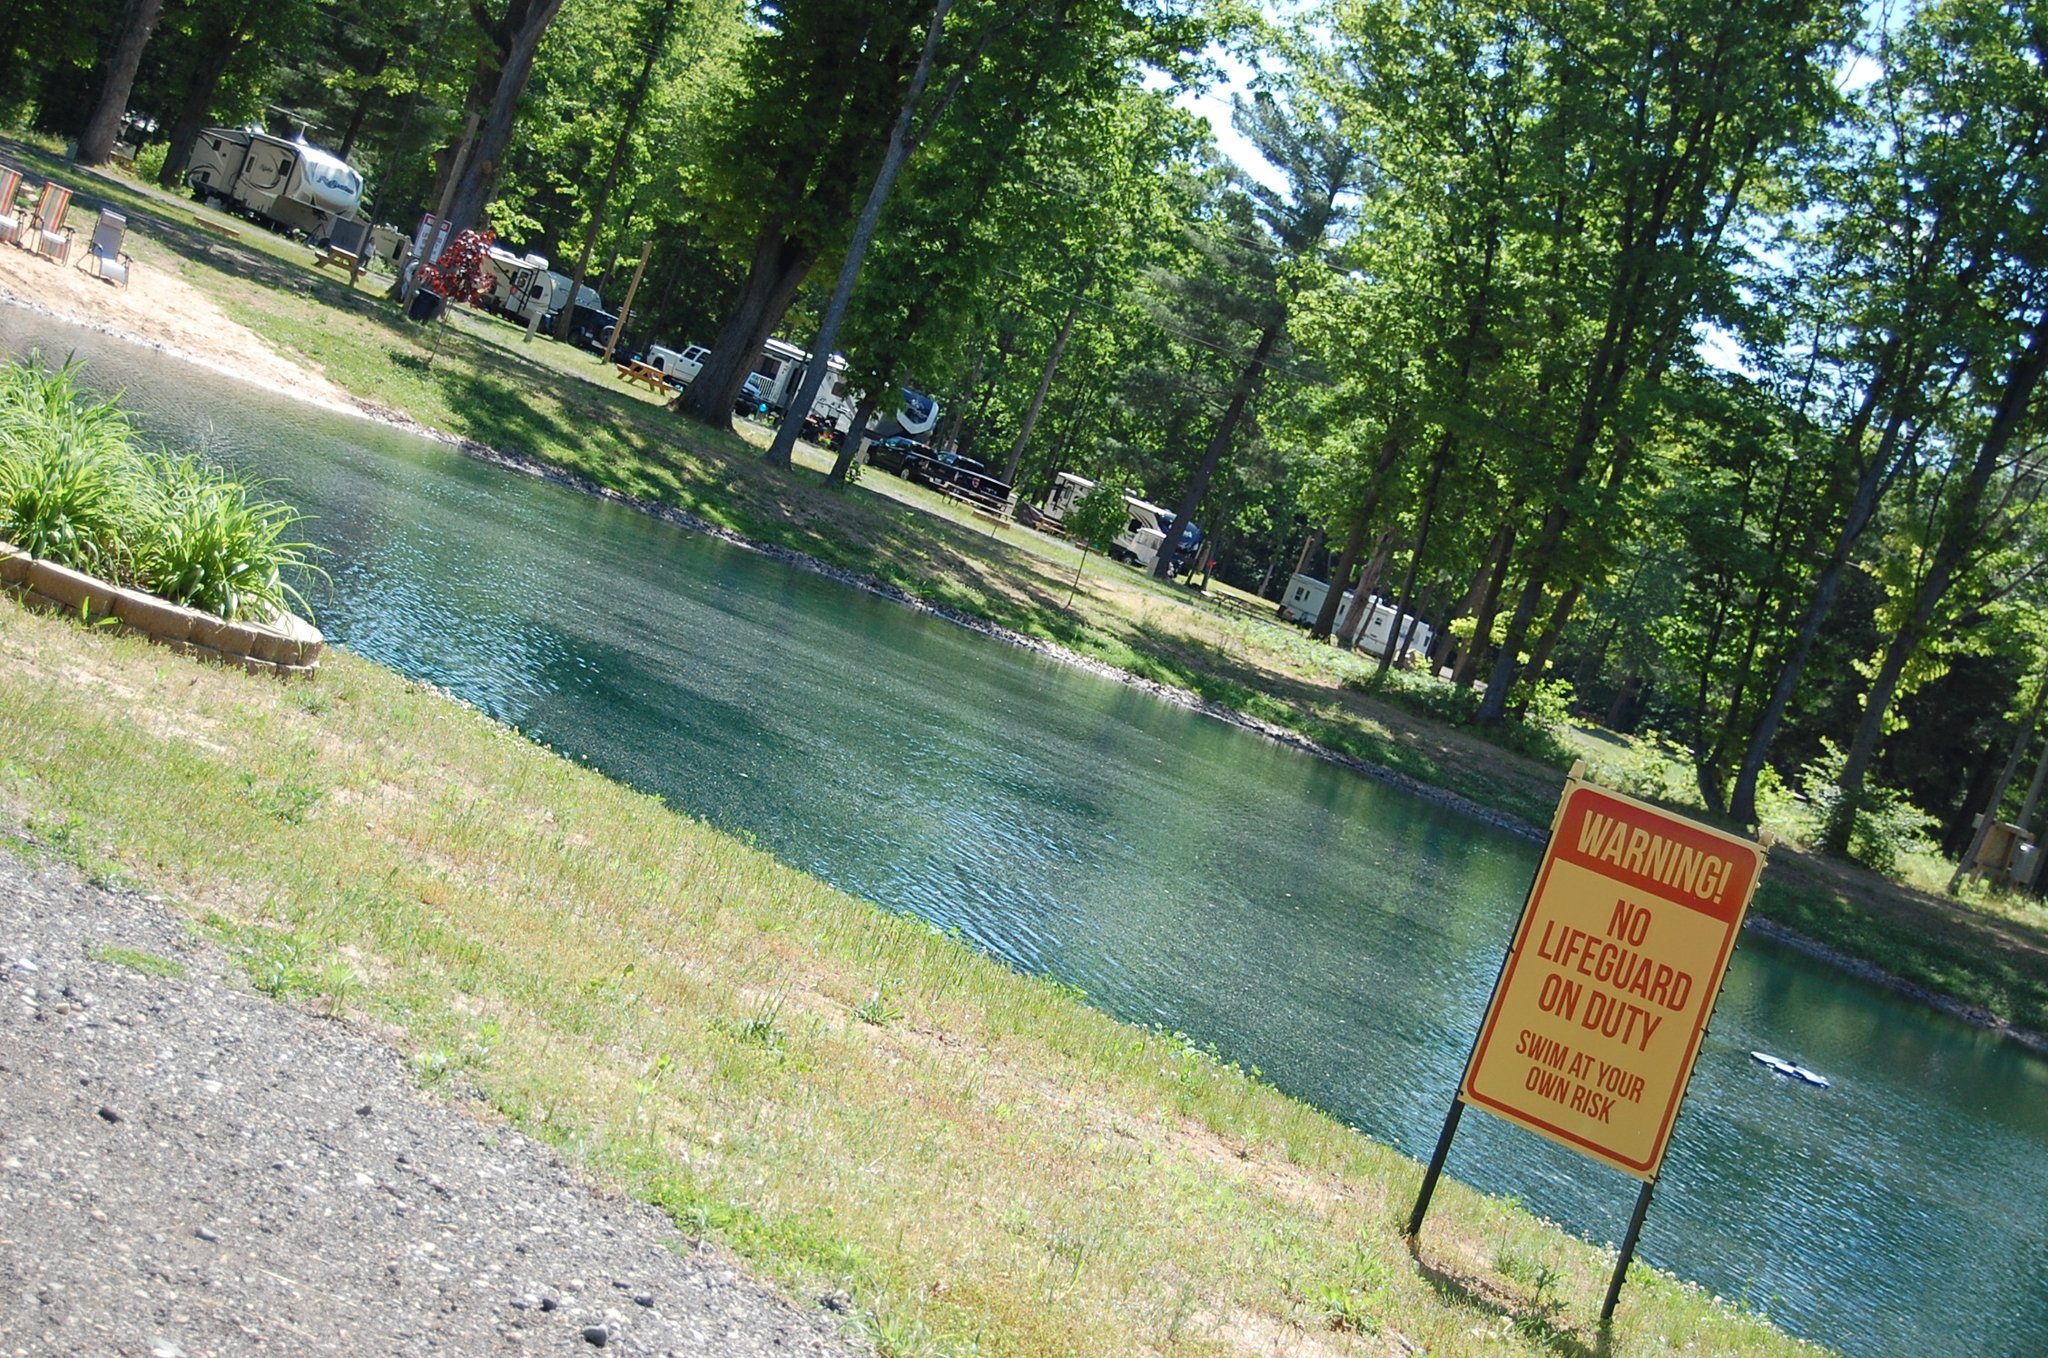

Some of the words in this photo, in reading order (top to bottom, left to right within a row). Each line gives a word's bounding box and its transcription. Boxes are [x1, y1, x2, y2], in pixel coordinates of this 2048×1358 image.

[1577, 809, 1733, 904] WARNING!
[1607, 900, 1652, 947] NO
[1537, 920, 1693, 1012] LIFEGUARD
[1538, 973, 1583, 1021] ON
[1582, 990, 1663, 1052] DUTY
[1515, 1029, 1572, 1071] SWIM
[1568, 1051, 1596, 1081] AT
[1597, 1061, 1646, 1104] YOUR
[1525, 1066, 1571, 1104] OWN
[1570, 1086, 1617, 1124] RISK
